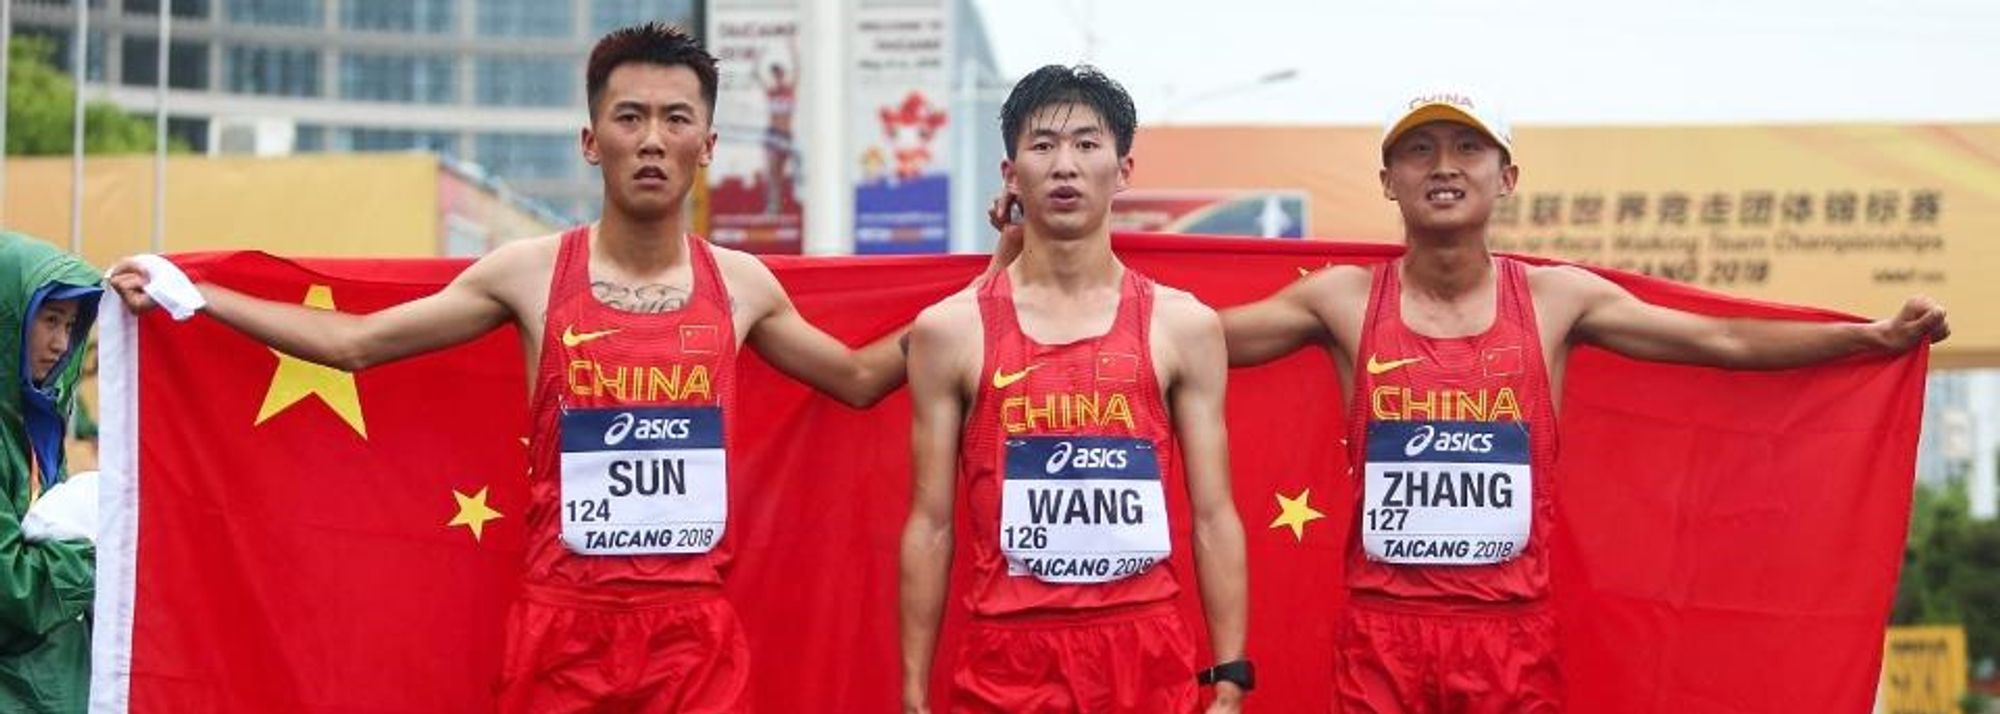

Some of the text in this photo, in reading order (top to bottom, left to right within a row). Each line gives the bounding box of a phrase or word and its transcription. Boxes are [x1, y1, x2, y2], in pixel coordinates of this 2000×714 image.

[568, 360, 711, 401] CHINA
[1002, 391, 1135, 433] CHINA
[1372, 385, 1523, 422] CHINA
[608, 458, 687, 497] SUN
[1381, 471, 1513, 508] ZHANG
[566, 499, 612, 522] 124
[1026, 488, 1144, 525] WANG
[1367, 508, 1410, 531] 127
[585, 528, 714, 549] TAICANG 2018
[1004, 526, 1048, 549] 126
[1383, 540, 1514, 559] TAICANG 2018
[1022, 556, 1154, 577] TAICANG 2018
